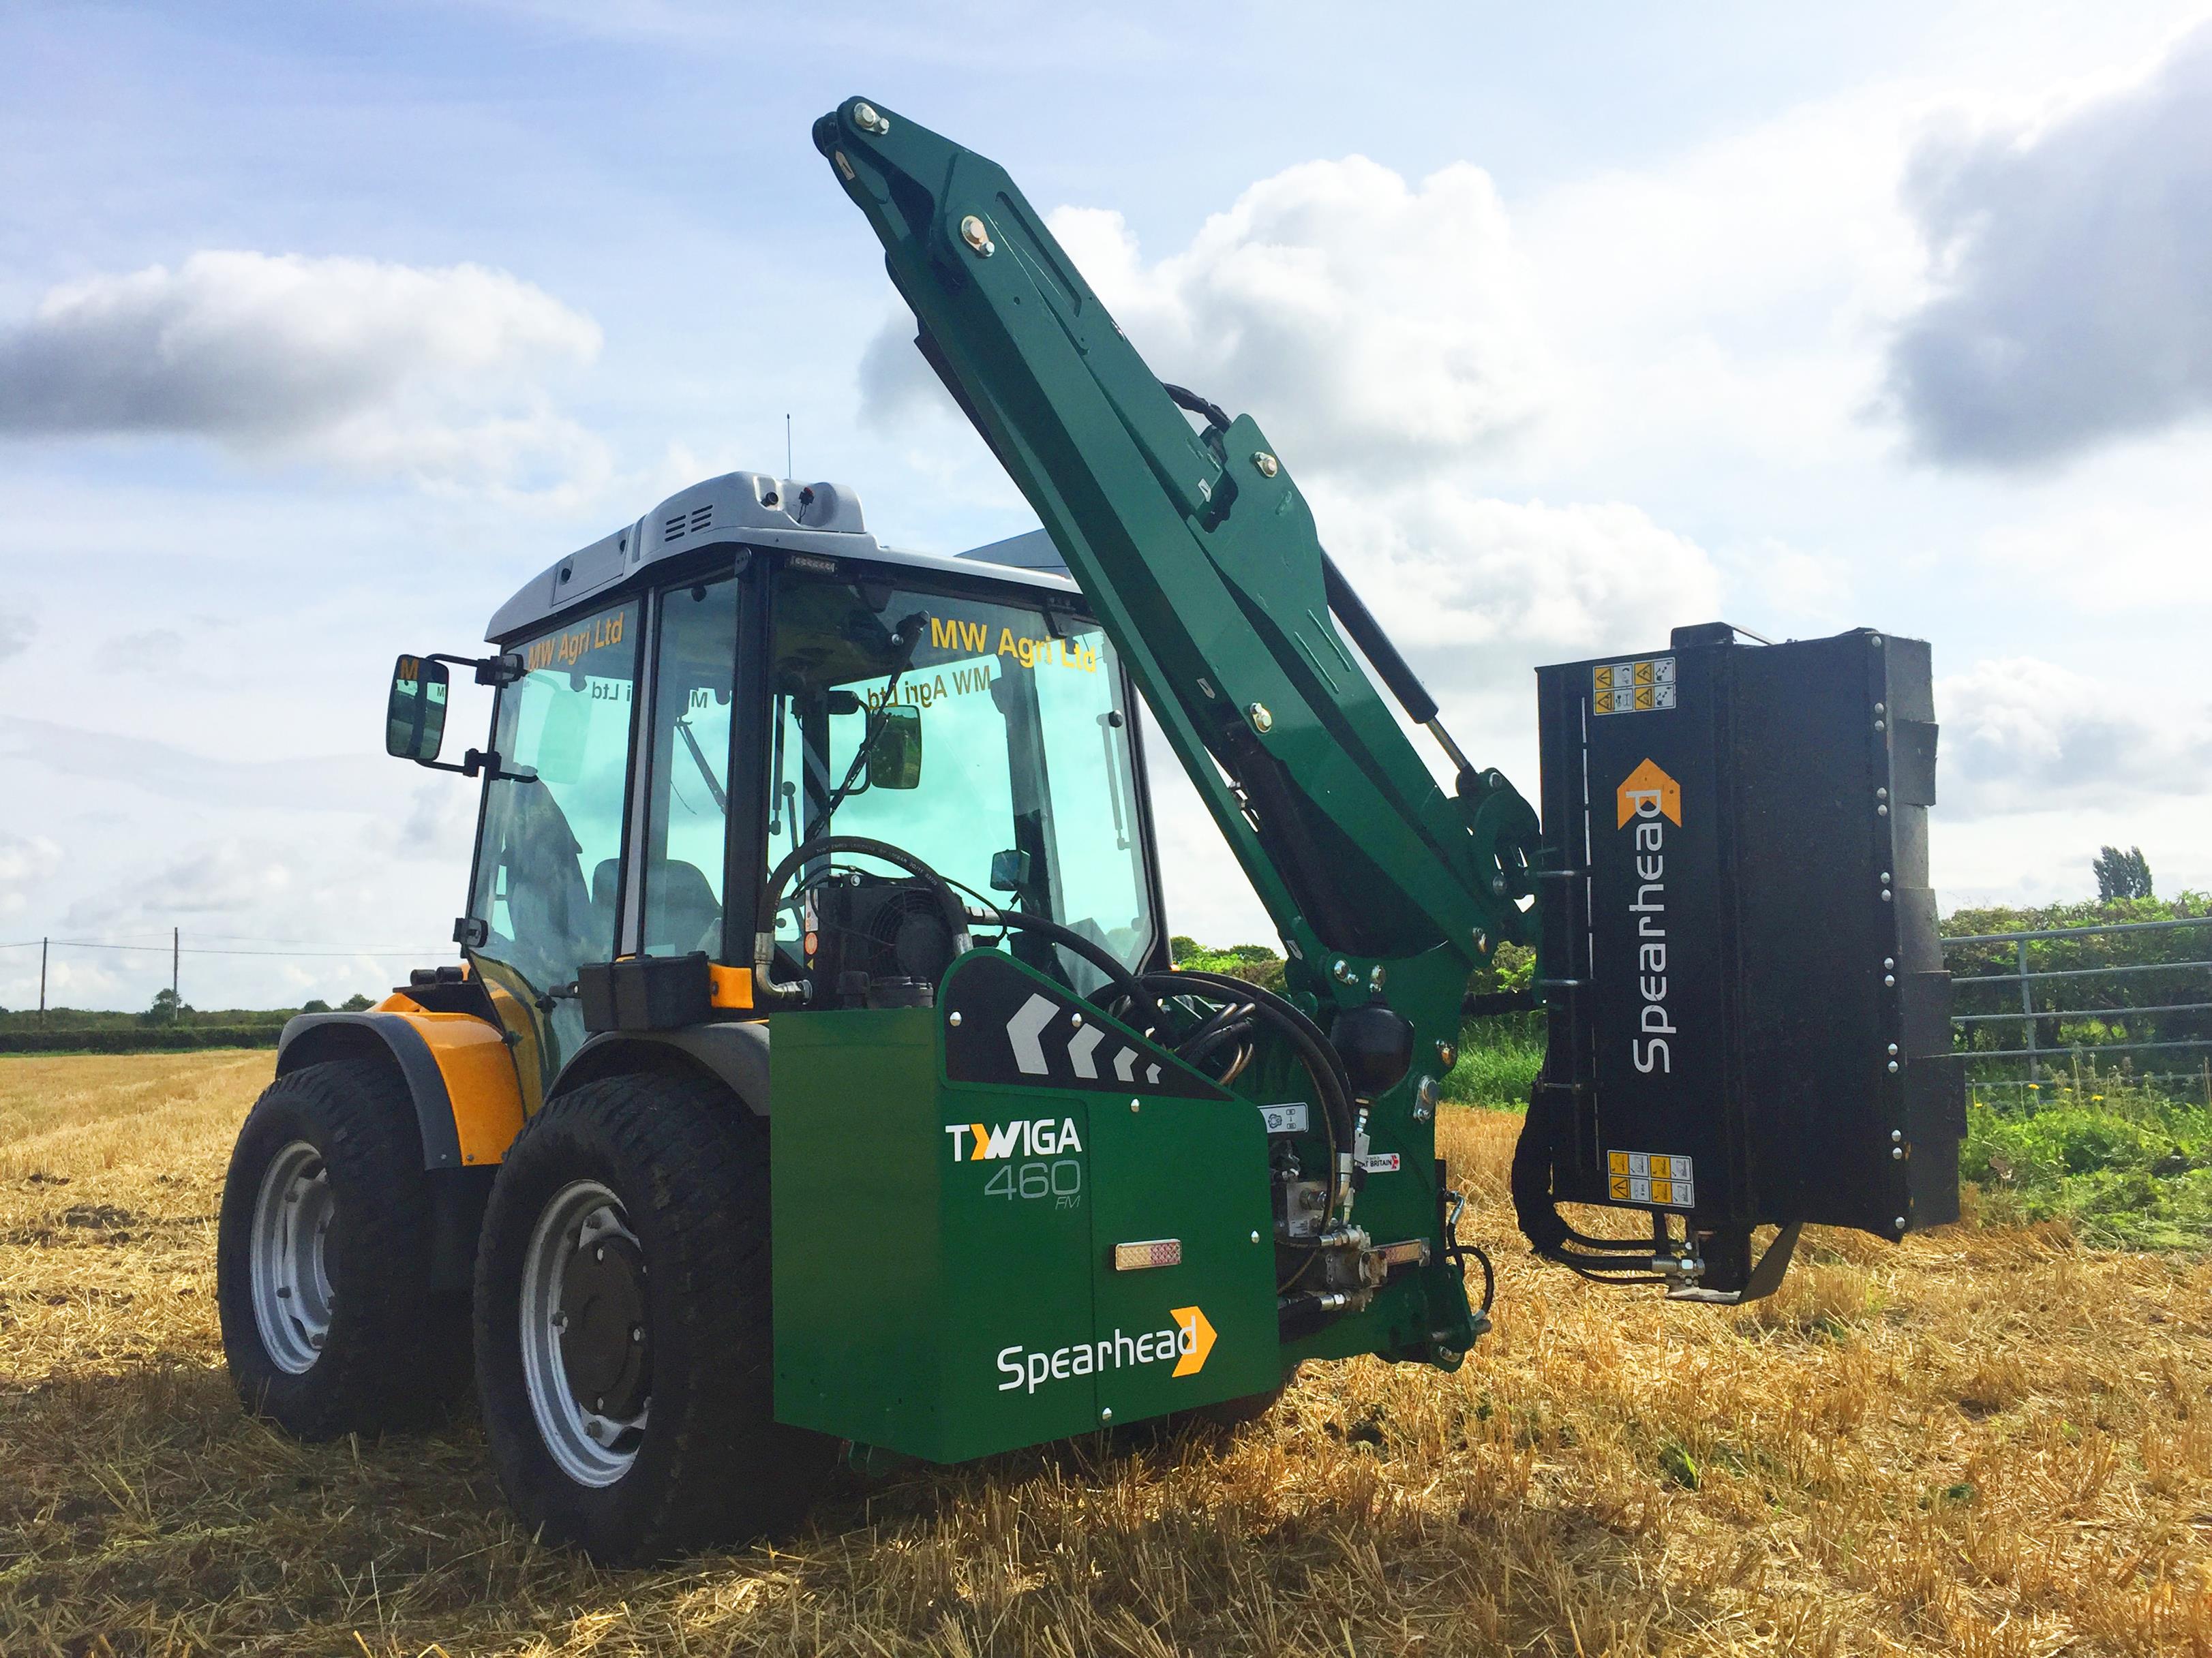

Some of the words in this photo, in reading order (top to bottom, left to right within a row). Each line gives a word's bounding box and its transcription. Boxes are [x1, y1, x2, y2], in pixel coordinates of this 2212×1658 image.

[528, 638, 556, 671] MW
[558, 624, 591, 666] Agri
[594, 611, 624, 649] Ltd
[930, 617, 987, 654] MW
[998, 628, 1052, 669] Agri
[1061, 638, 1097, 673] Ltd
[1626, 789, 1676, 1073] Spearhead
[945, 1118, 1082, 1161] TWIGA
[1370, 1159, 1392, 1167] BRITAIN
[984, 1160, 1081, 1200] 460
[1055, 1195, 1080, 1210] FM
[997, 1315, 1198, 1394] Spearhead
